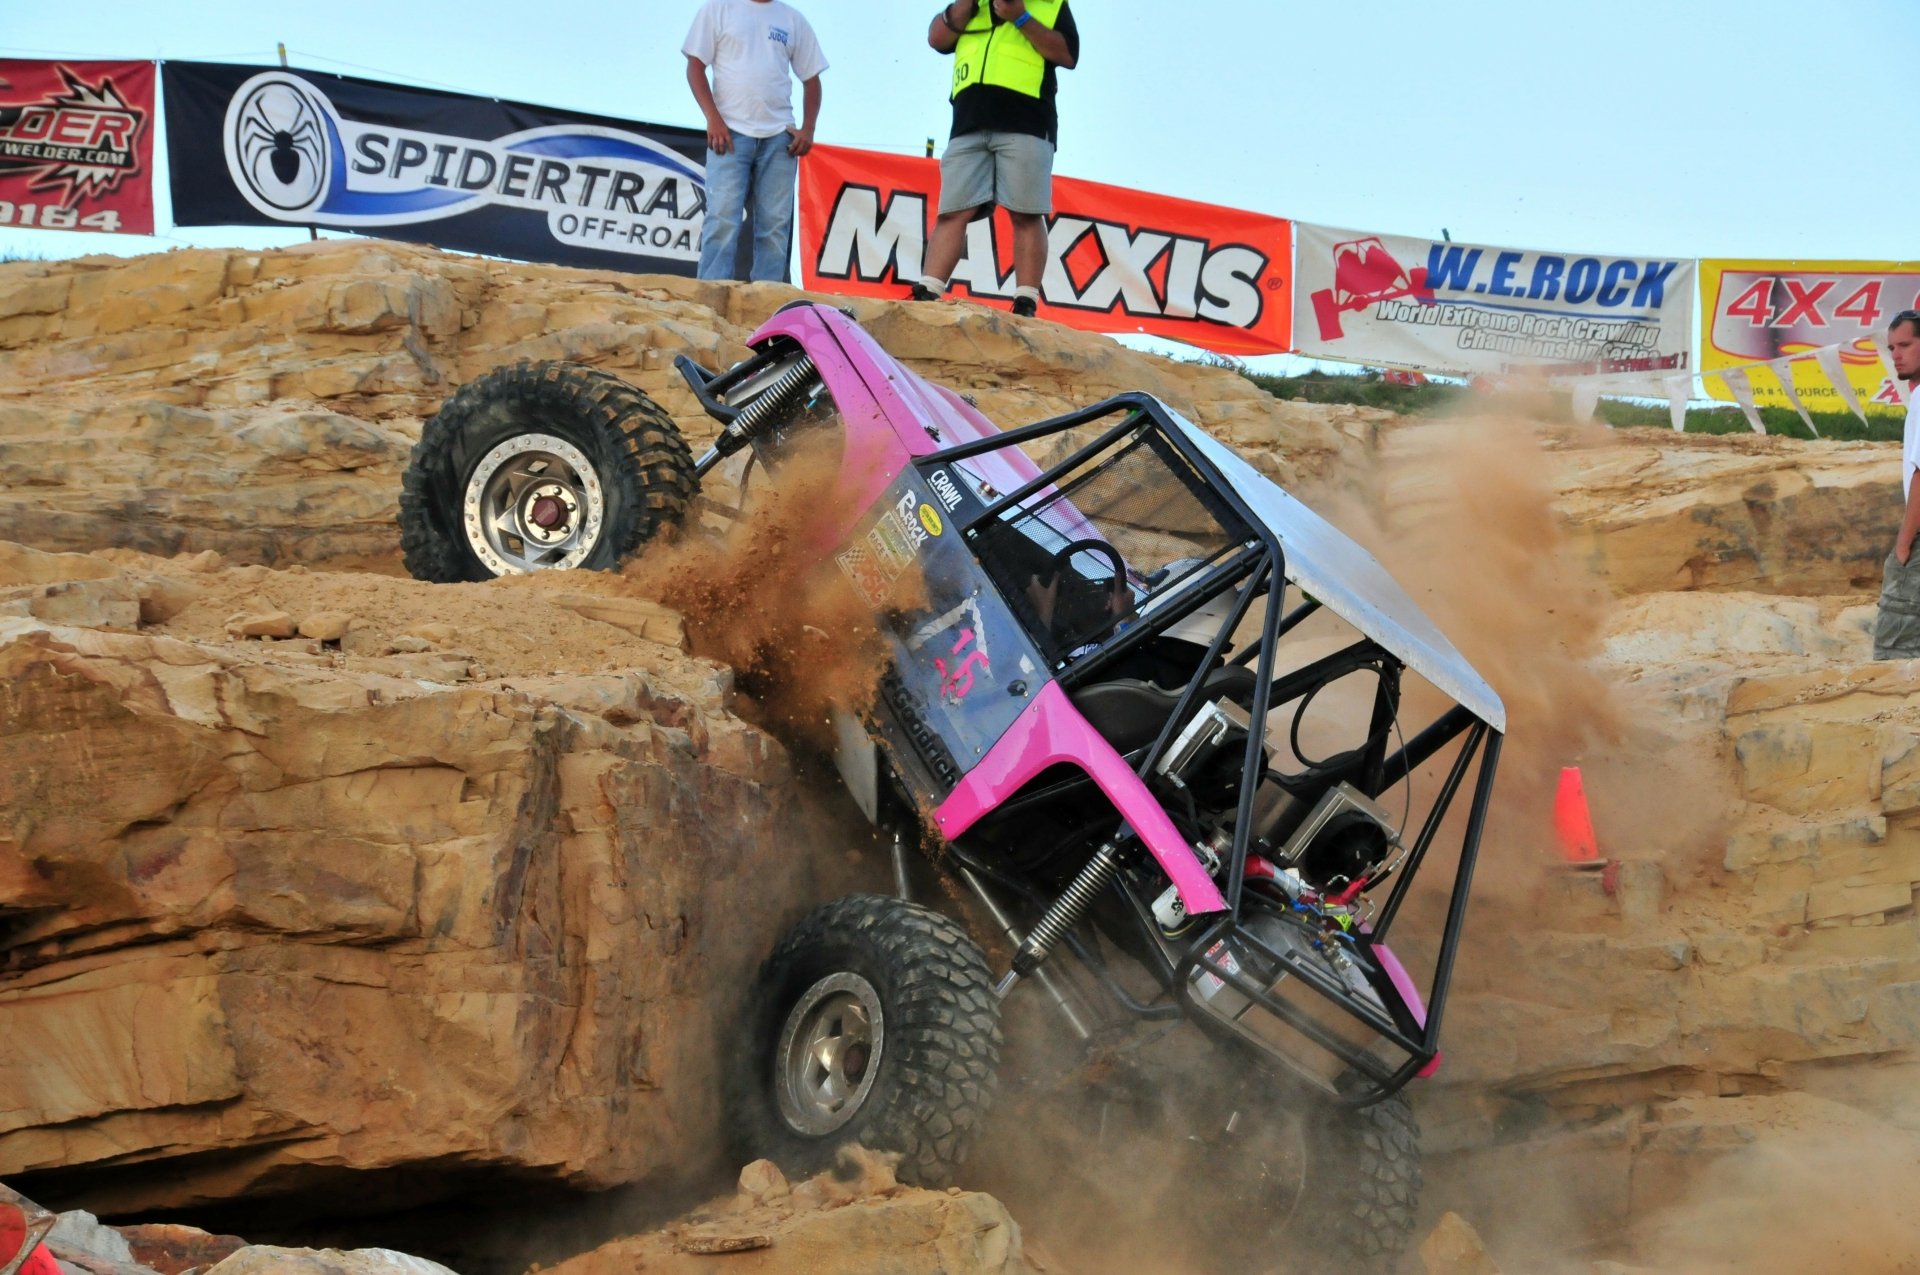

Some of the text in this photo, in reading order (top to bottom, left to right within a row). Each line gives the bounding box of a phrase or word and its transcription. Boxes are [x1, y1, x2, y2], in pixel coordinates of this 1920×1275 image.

[0, 142, 126, 166] WELDER.COM
[351, 133, 707, 221] SPIDERTRAX
[557, 213, 702, 252] OFF-ROA
[817, 181, 1270, 329] MAXXIS
[1425, 244, 1679, 310] W.E.ROCK
[1376, 299, 1661, 348] World Extreme Rock Crawling
[1794, 386, 1838, 398] OURCE
[930, 469, 963, 511] CRAWL
